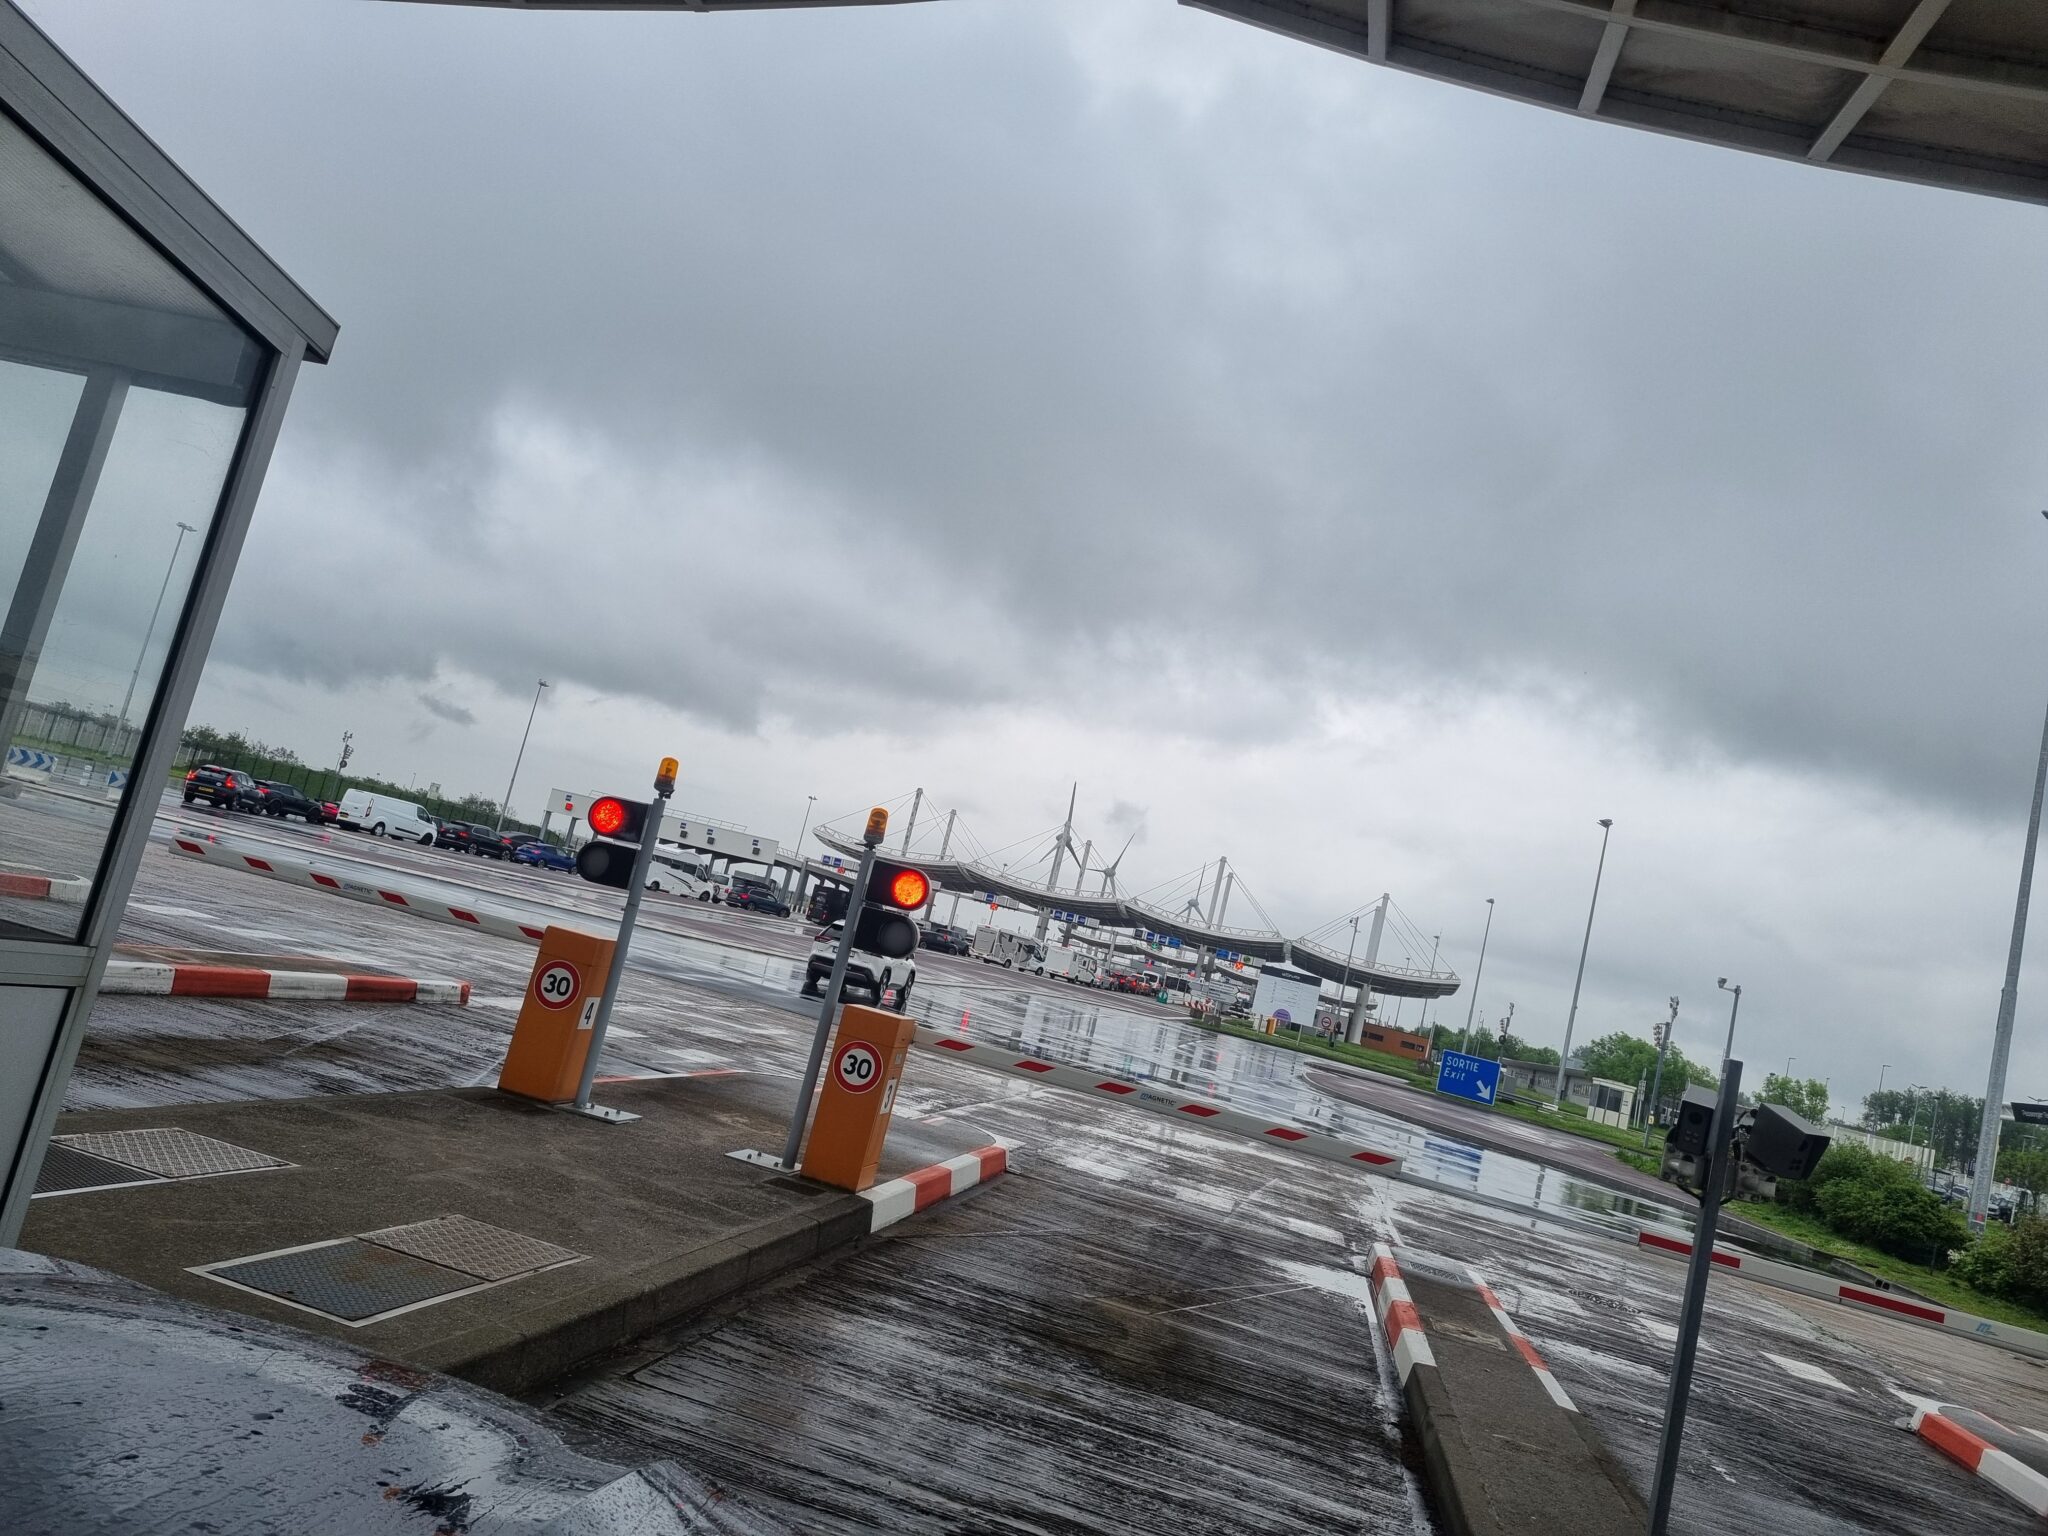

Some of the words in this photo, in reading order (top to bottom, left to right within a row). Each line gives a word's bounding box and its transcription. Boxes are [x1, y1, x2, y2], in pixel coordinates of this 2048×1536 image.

[543, 973, 571, 997] 30
[584, 1002, 595, 1025] 4
[843, 1053, 872, 1080] 30
[1443, 1067, 1466, 1081] Exit
[1446, 1056, 1480, 1073] SORTIE
